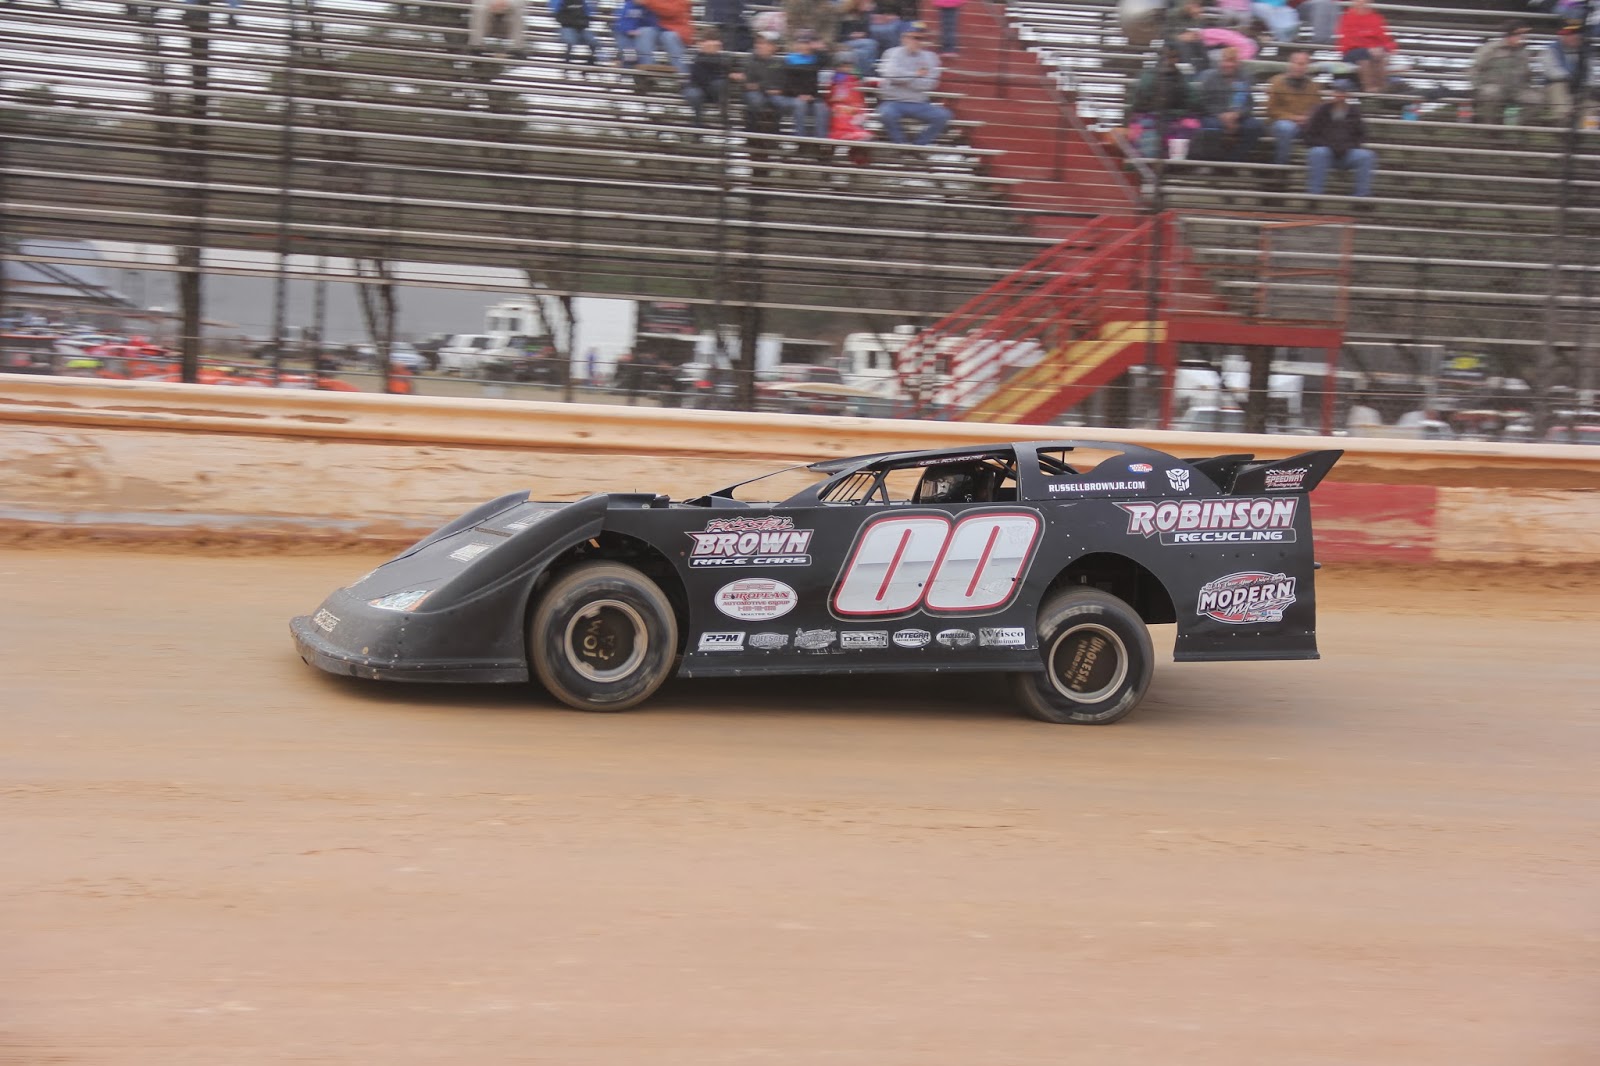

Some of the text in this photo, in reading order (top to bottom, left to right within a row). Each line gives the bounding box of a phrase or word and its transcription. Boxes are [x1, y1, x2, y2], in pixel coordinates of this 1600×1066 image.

[1265, 473, 1305, 484] SPEEDWAY
[1048, 481, 1146, 492] RUSSELLBROWNJR.COM
[1125, 500, 1296, 534] ROBINSON
[1174, 531, 1284, 543] RECYCLING
[691, 531, 812, 557] BROWN
[692, 558, 749, 566] RACE
[833, 512, 1041, 615] 00
[721, 591, 791, 601] EUROPEAN
[1199, 580, 1292, 611] MODERN
[705, 634, 739, 642] PPM
[980, 630, 1024, 638] Wrisco
[1070, 636, 1107, 692] WHOLESAE
